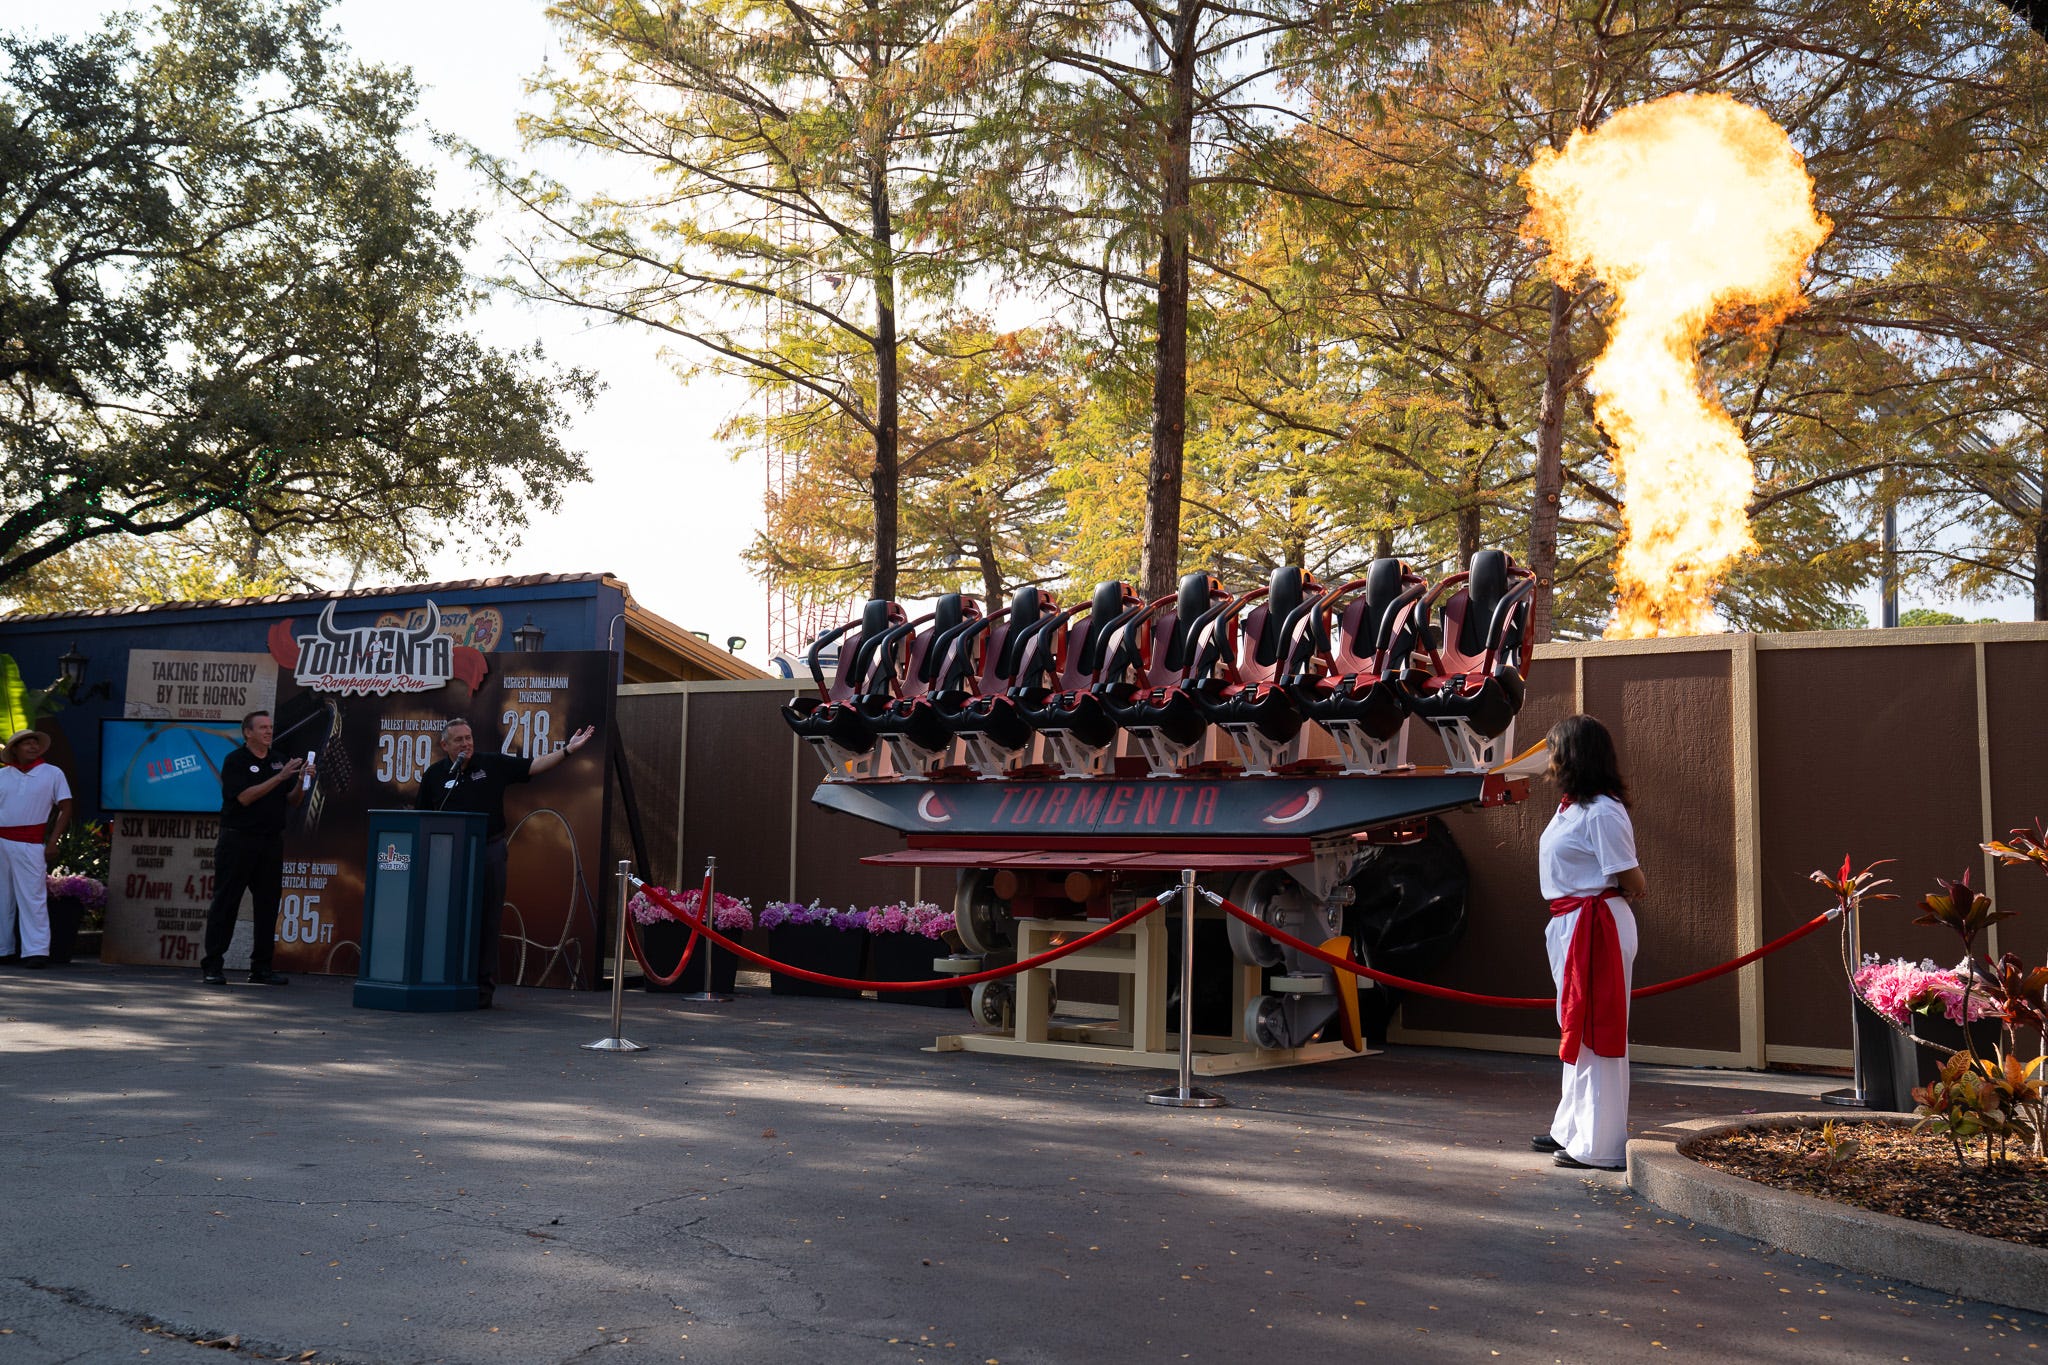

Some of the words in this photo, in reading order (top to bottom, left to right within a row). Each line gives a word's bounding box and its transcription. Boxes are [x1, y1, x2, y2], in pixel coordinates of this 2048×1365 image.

[440, 613, 468, 627] ESTA
[297, 629, 450, 677] TORMENTA
[152, 661, 199, 682] TAKING
[202, 662, 257, 683] HISTORY
[315, 674, 392, 694] Rampaging
[392, 673, 429, 690] Run
[503, 676, 528, 689] HIGHEST
[529, 676, 569, 689] IMMELMANN
[156, 684, 173, 704] BY
[177, 685, 200, 705] THE
[202, 686, 247, 706] HORNS
[518, 691, 551, 703] INVERSION
[178, 707, 205, 718] COMING
[381, 719, 403, 731] TALLEST
[174, 754, 197, 771] FEET
[377, 734, 432, 783] 309
[991, 785, 1221, 825] TORMENTA
[121, 817, 144, 838] SIX
[147, 818, 191, 839] WORLD
[195, 819, 218, 840] REC
[281, 876, 307, 889] ERTICAL
